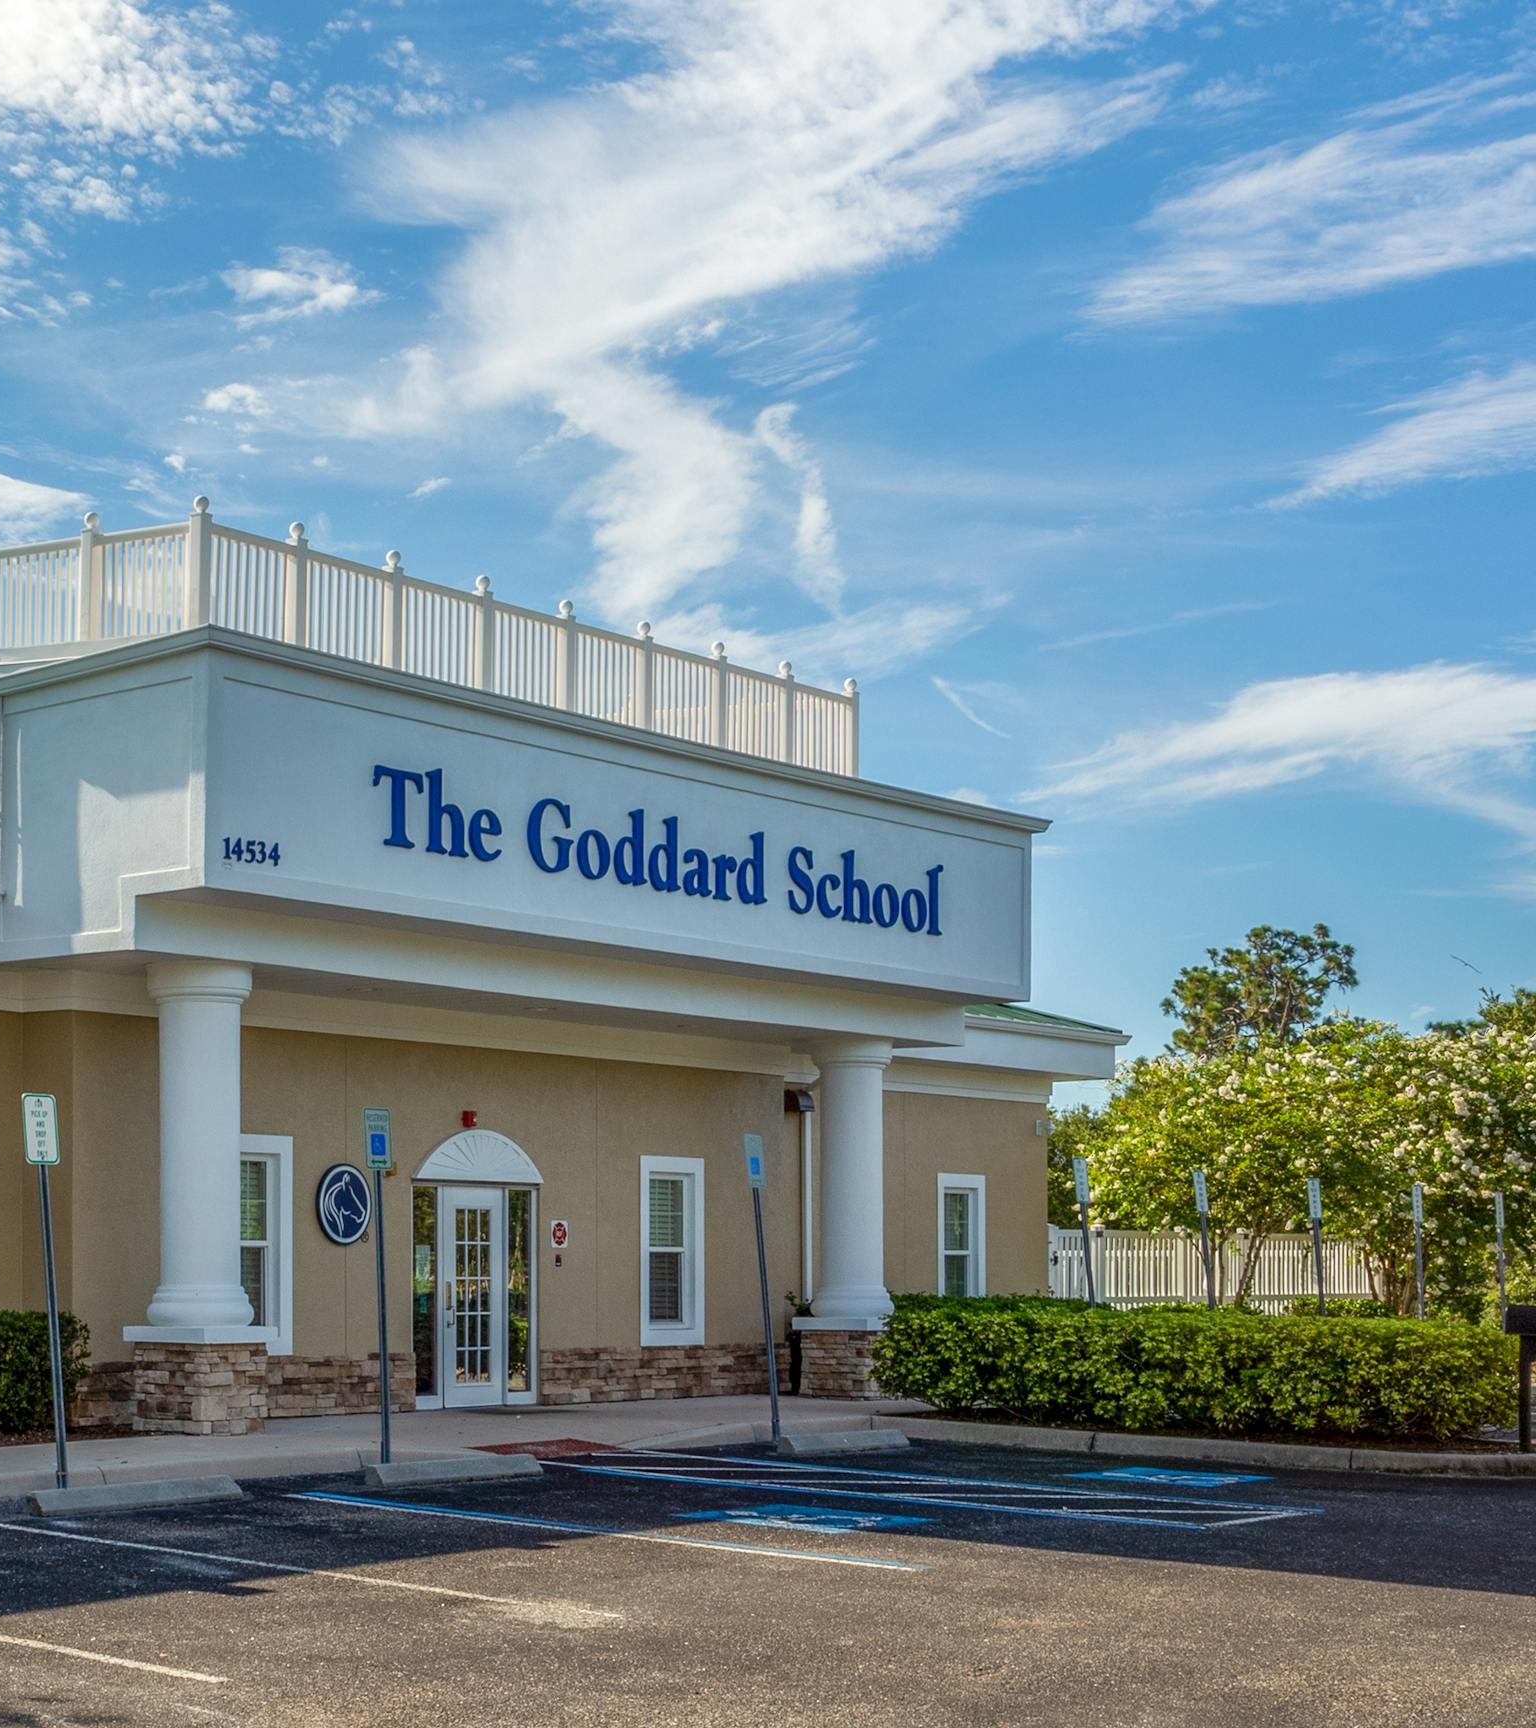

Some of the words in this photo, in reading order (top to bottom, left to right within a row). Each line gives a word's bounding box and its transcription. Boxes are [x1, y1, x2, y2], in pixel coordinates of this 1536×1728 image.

[222, 836, 281, 867] 14534
[372, 764, 503, 862] The
[526, 798, 768, 906] Goddard
[787, 846, 944, 936] School
